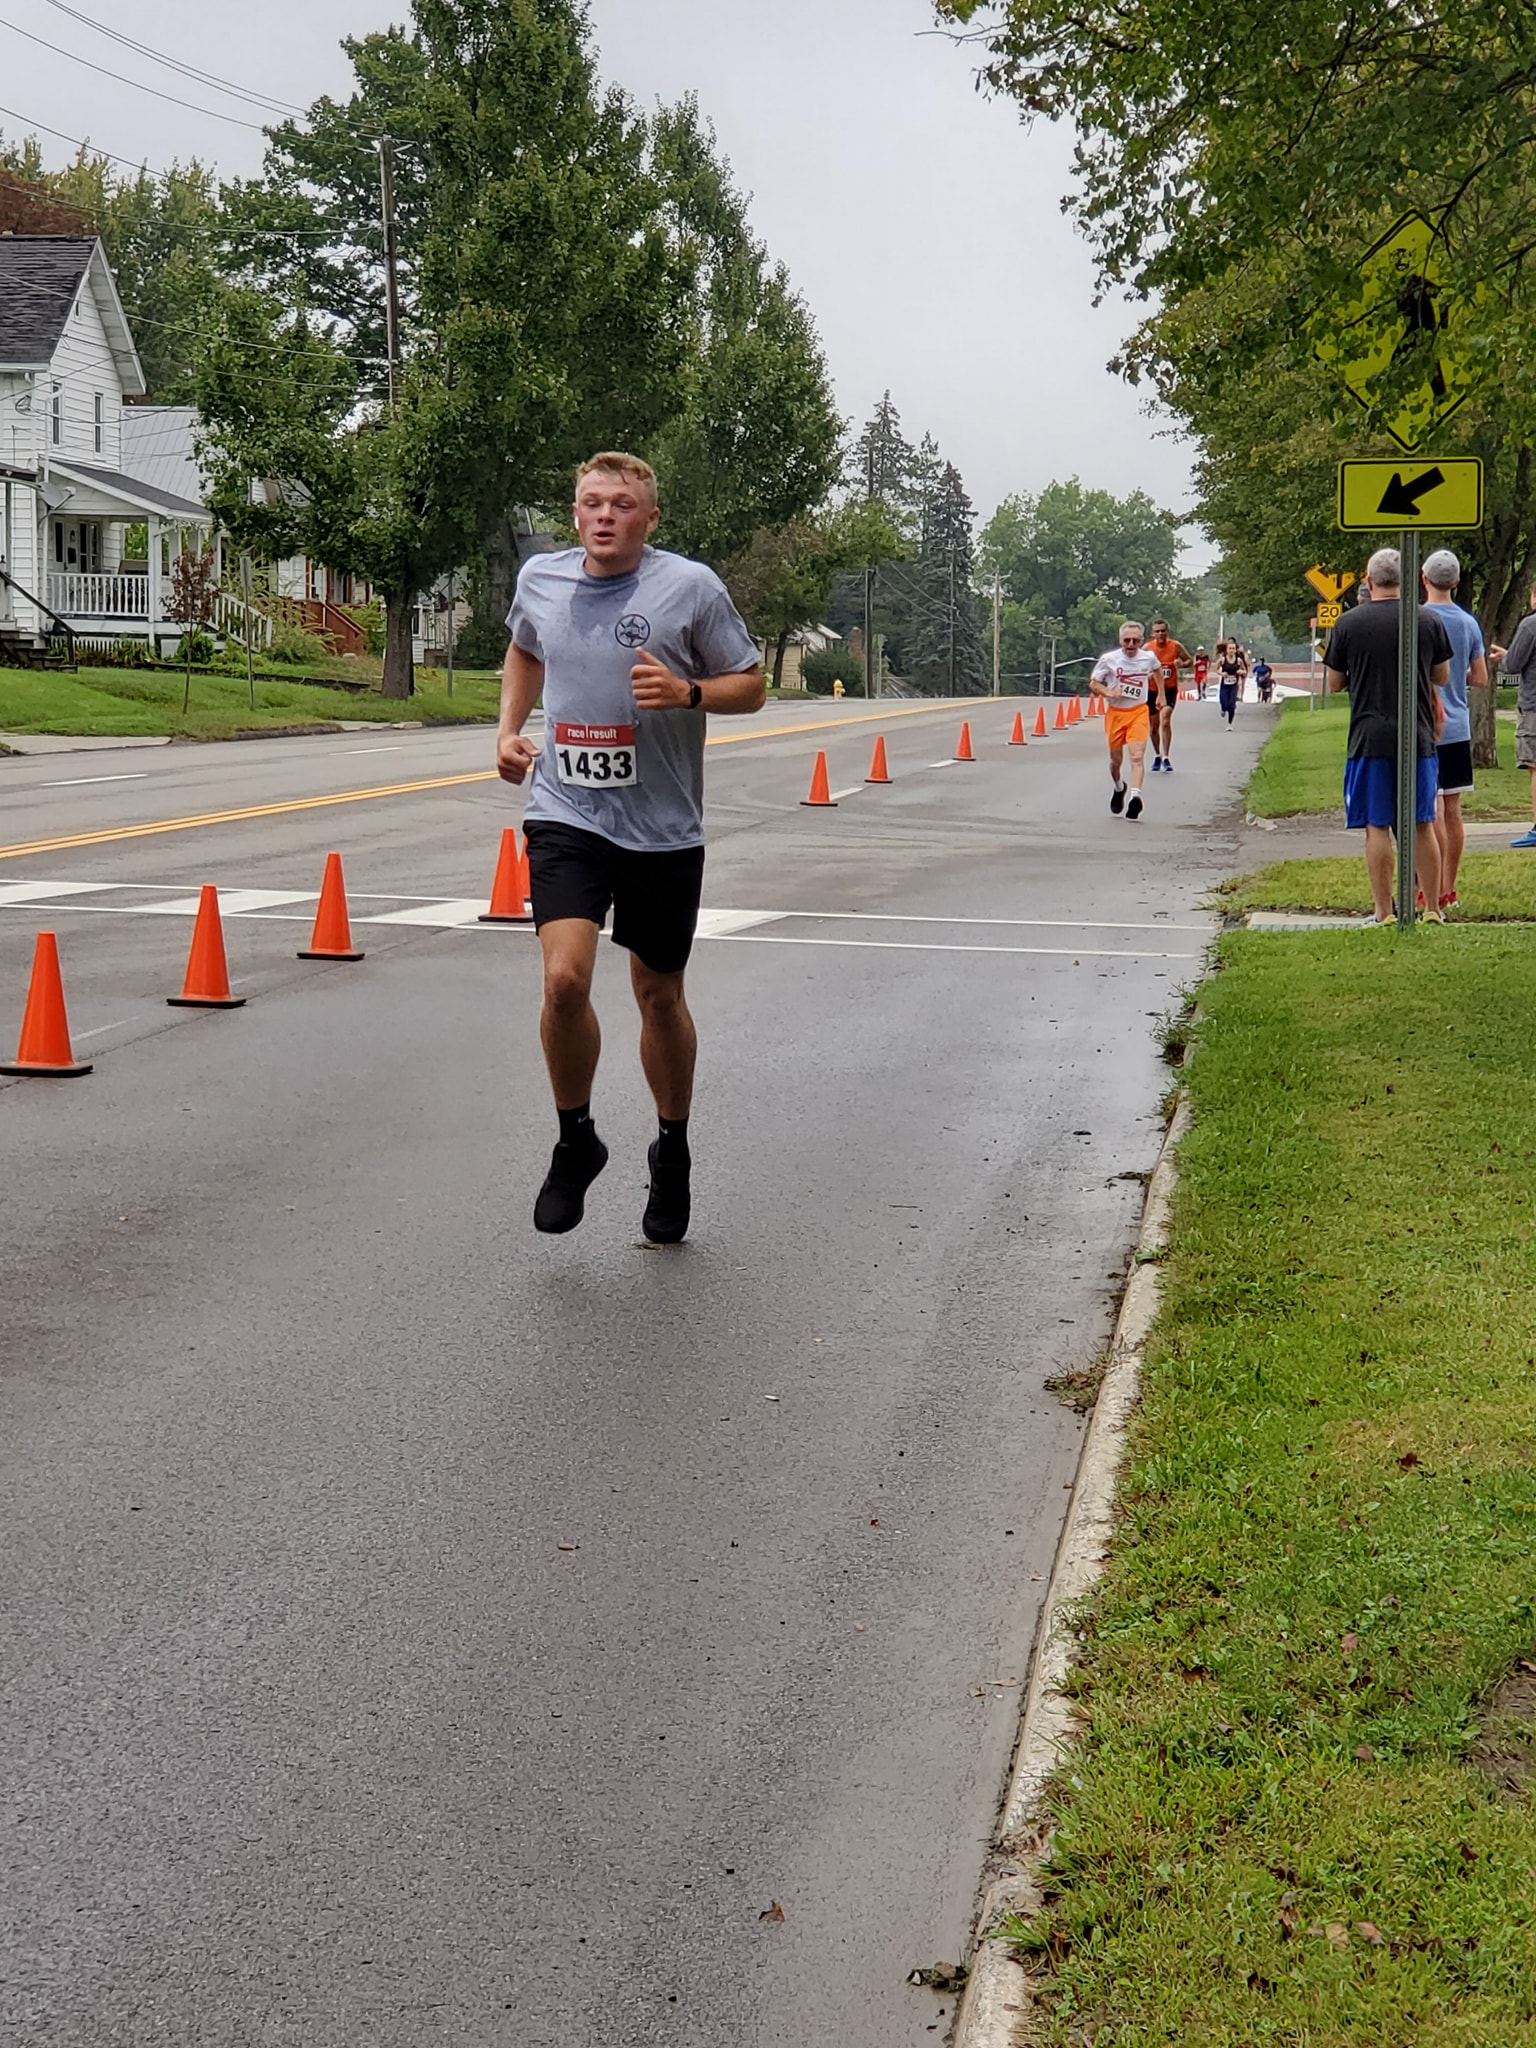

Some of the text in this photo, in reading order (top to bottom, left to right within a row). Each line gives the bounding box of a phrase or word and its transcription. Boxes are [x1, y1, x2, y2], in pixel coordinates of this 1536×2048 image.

[1320, 606, 1339, 618] 20
[1120, 685, 1142, 697] 449
[559, 749, 632, 781] 1433
